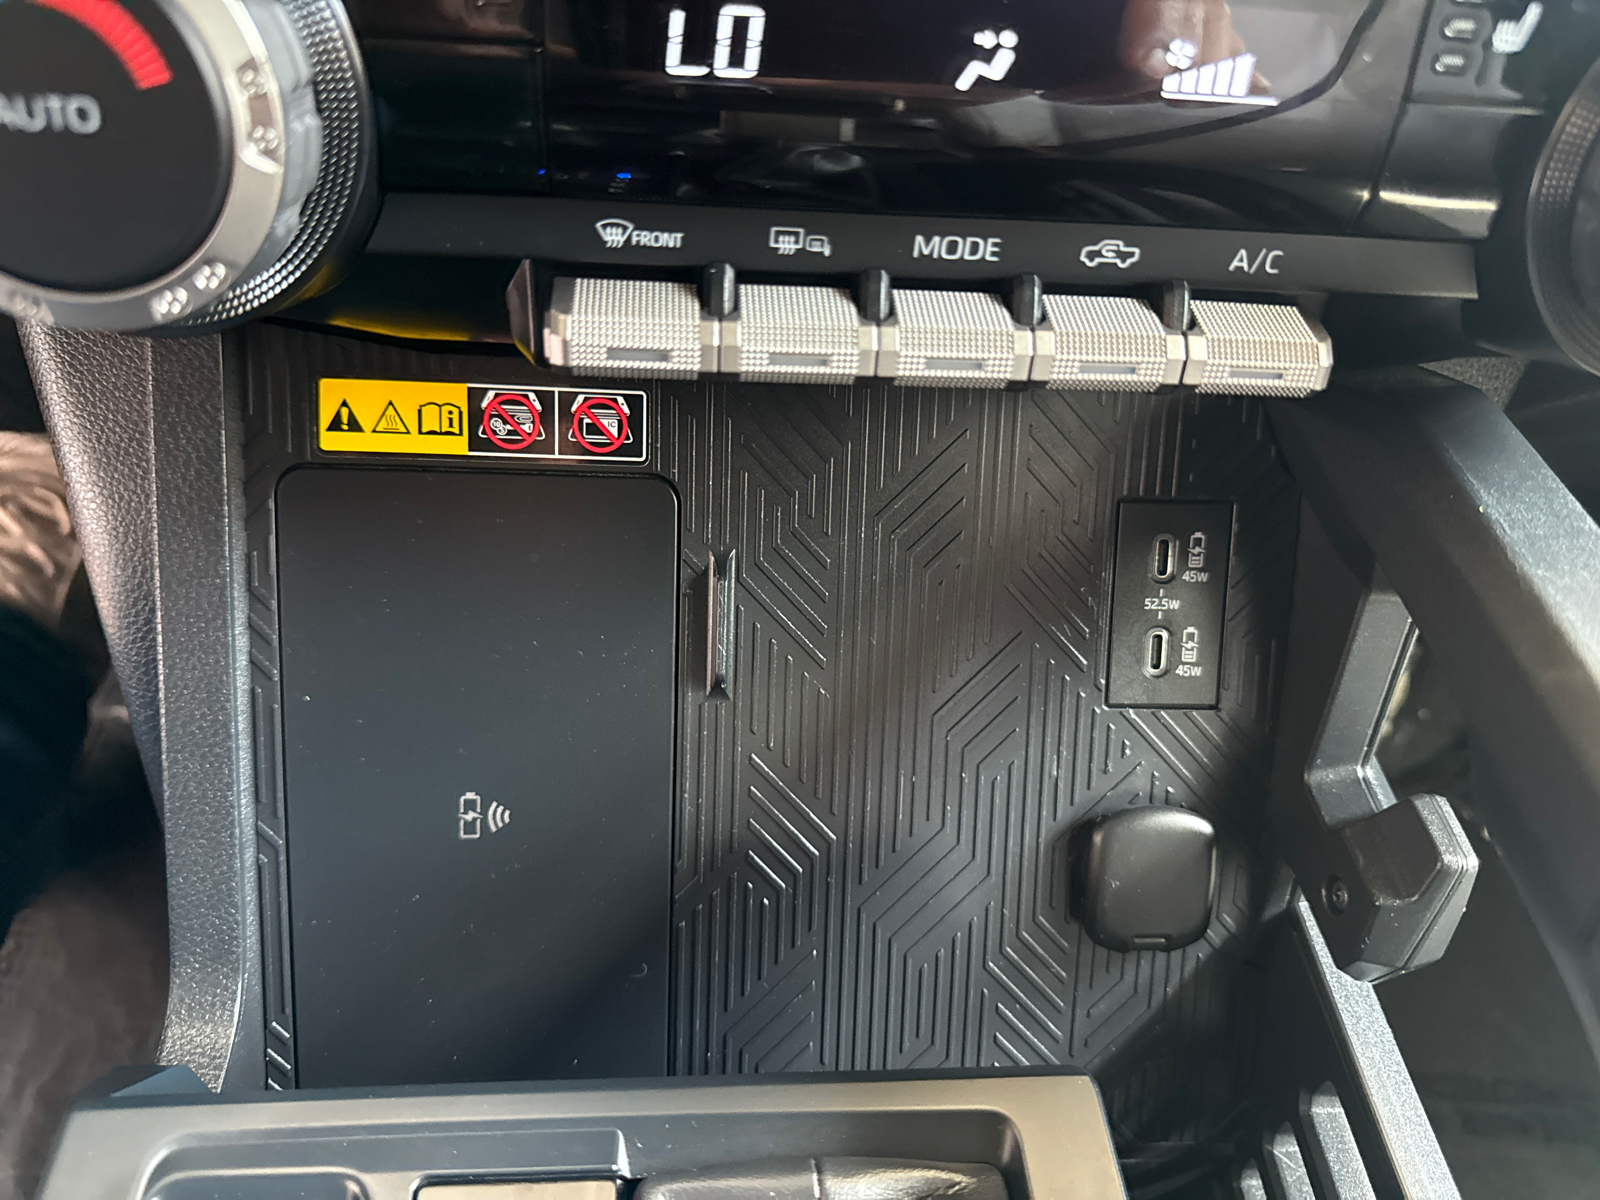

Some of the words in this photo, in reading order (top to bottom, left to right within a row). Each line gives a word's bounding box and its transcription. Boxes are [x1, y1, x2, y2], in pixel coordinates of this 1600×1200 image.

[664, 4, 766, 79] LO
[631, 230, 685, 248] FRONT
[912, 234, 1003, 262] MODE
[1228, 247, 1285, 274] A/C
[607, 420, 617, 429] IC
[1181, 571, 1208, 583] 45W
[1144, 598, 1180, 610] 52.5W
[1175, 665, 1203, 677] 45W
